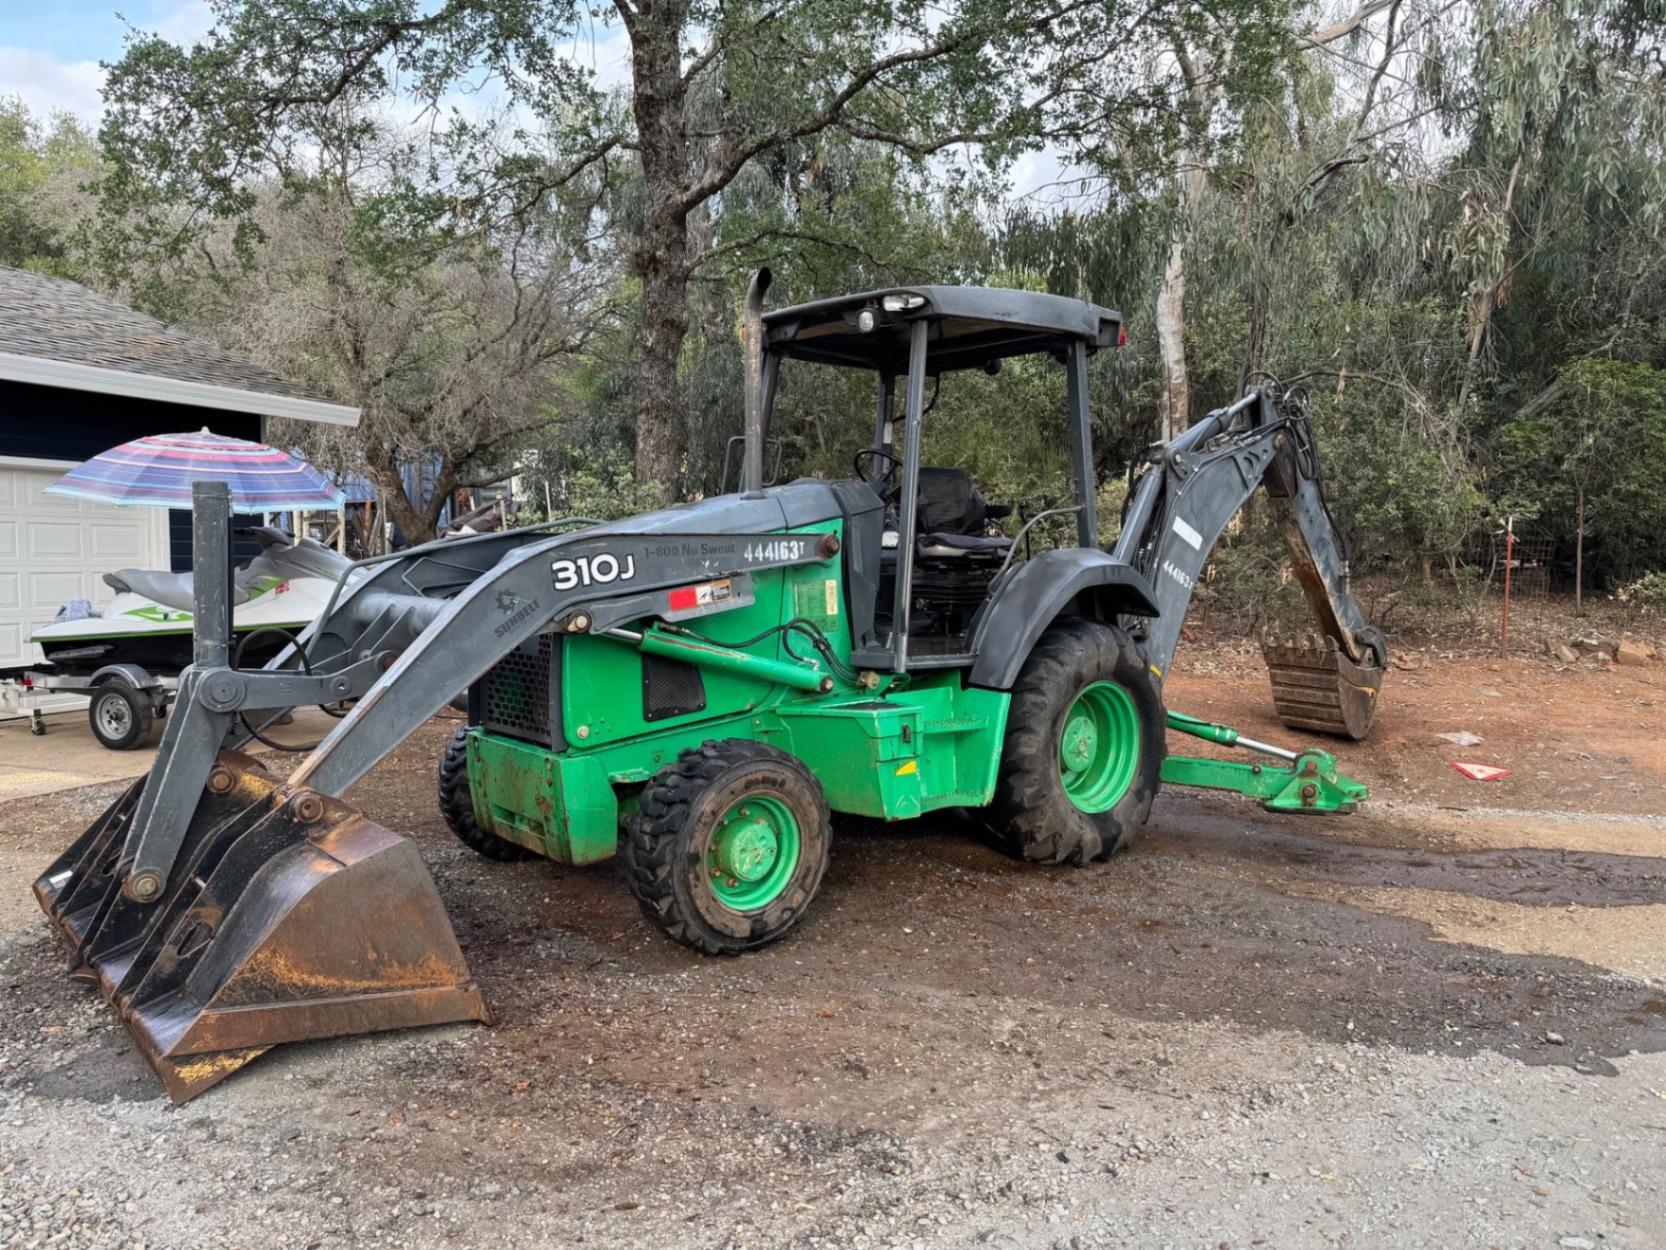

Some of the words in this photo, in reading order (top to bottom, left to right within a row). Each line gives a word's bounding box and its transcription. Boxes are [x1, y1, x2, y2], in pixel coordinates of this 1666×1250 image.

[644, 546, 678, 559] 1-800
[681, 543, 698, 556] No
[700, 542, 734, 555] Sweat
[551, 553, 635, 591] 310J
[493, 598, 540, 638] SUNBELT
